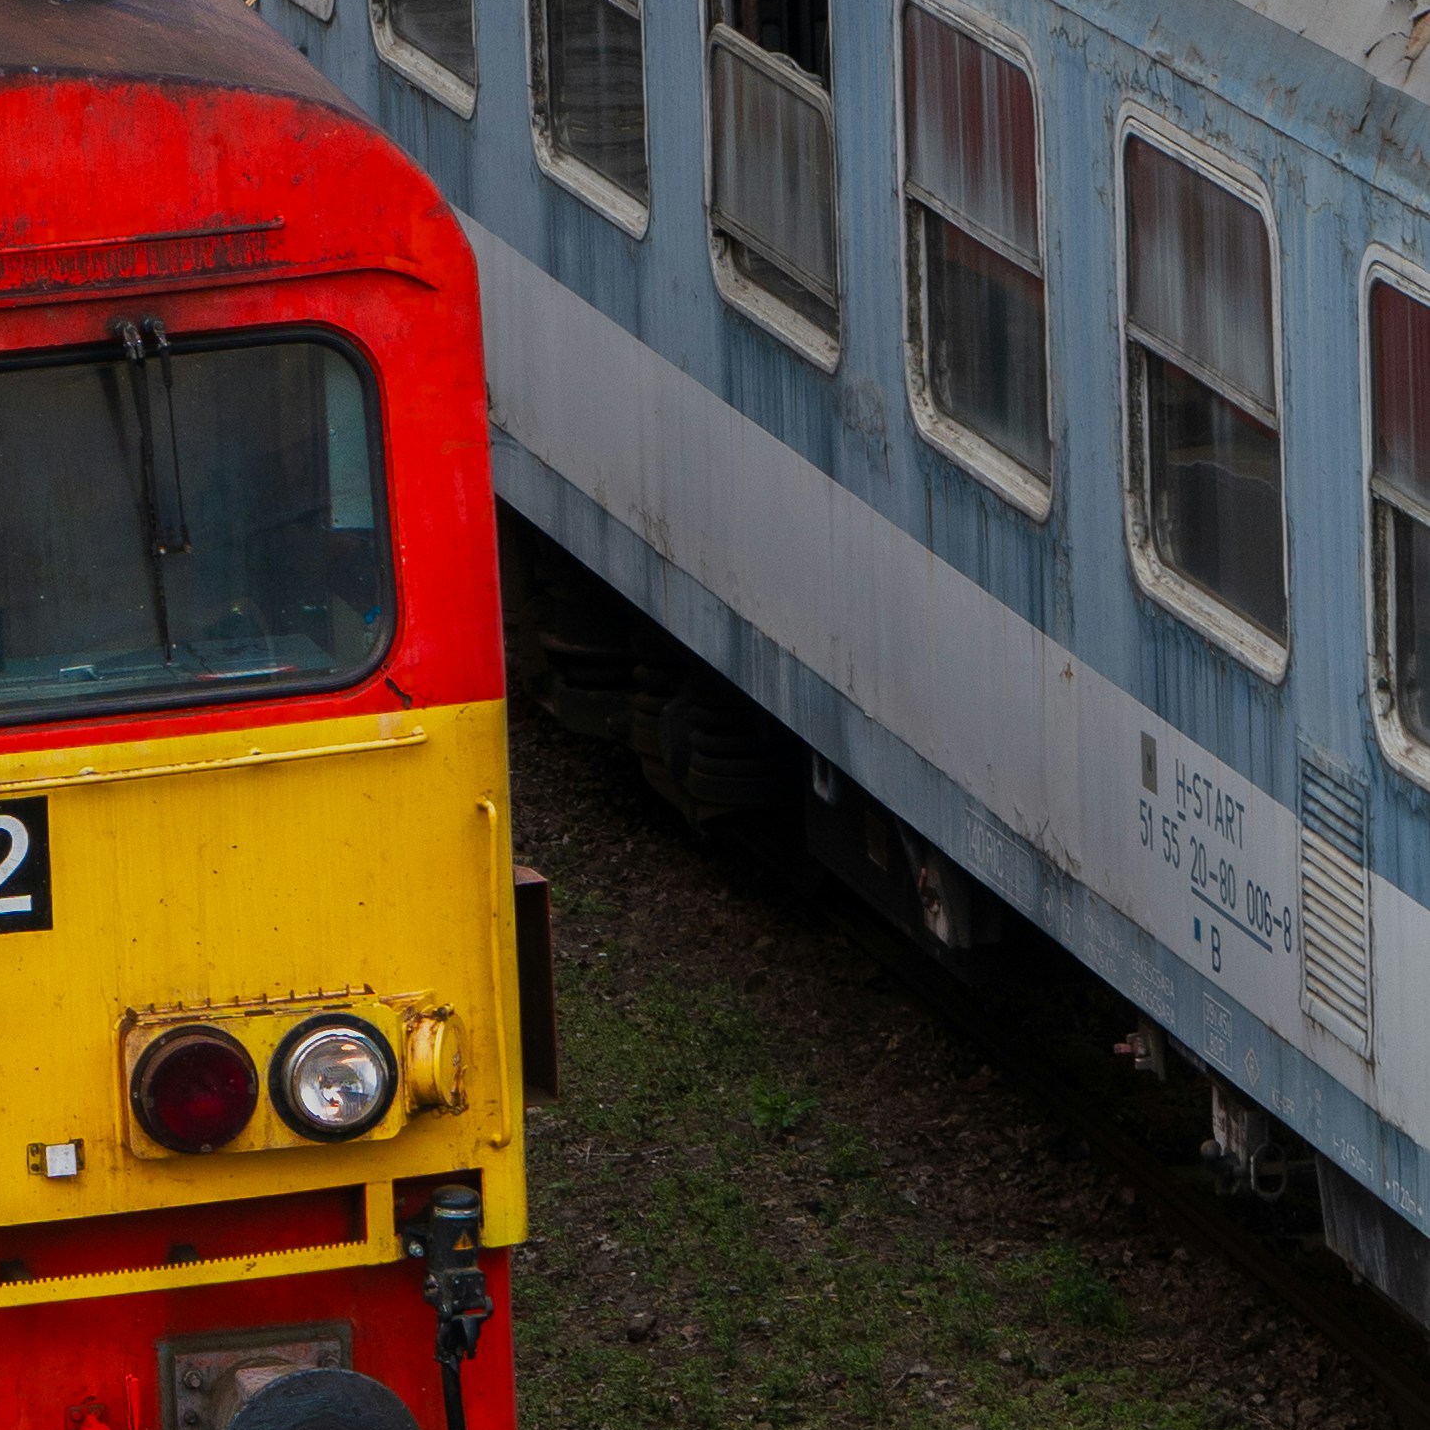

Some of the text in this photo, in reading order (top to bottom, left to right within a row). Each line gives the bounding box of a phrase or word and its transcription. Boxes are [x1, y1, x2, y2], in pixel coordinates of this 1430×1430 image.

[1174, 757, 1245, 851] H-START
[1138, 798, 1293, 954] 51 55 20-80 006-8
[1210, 925, 1223, 974] B
